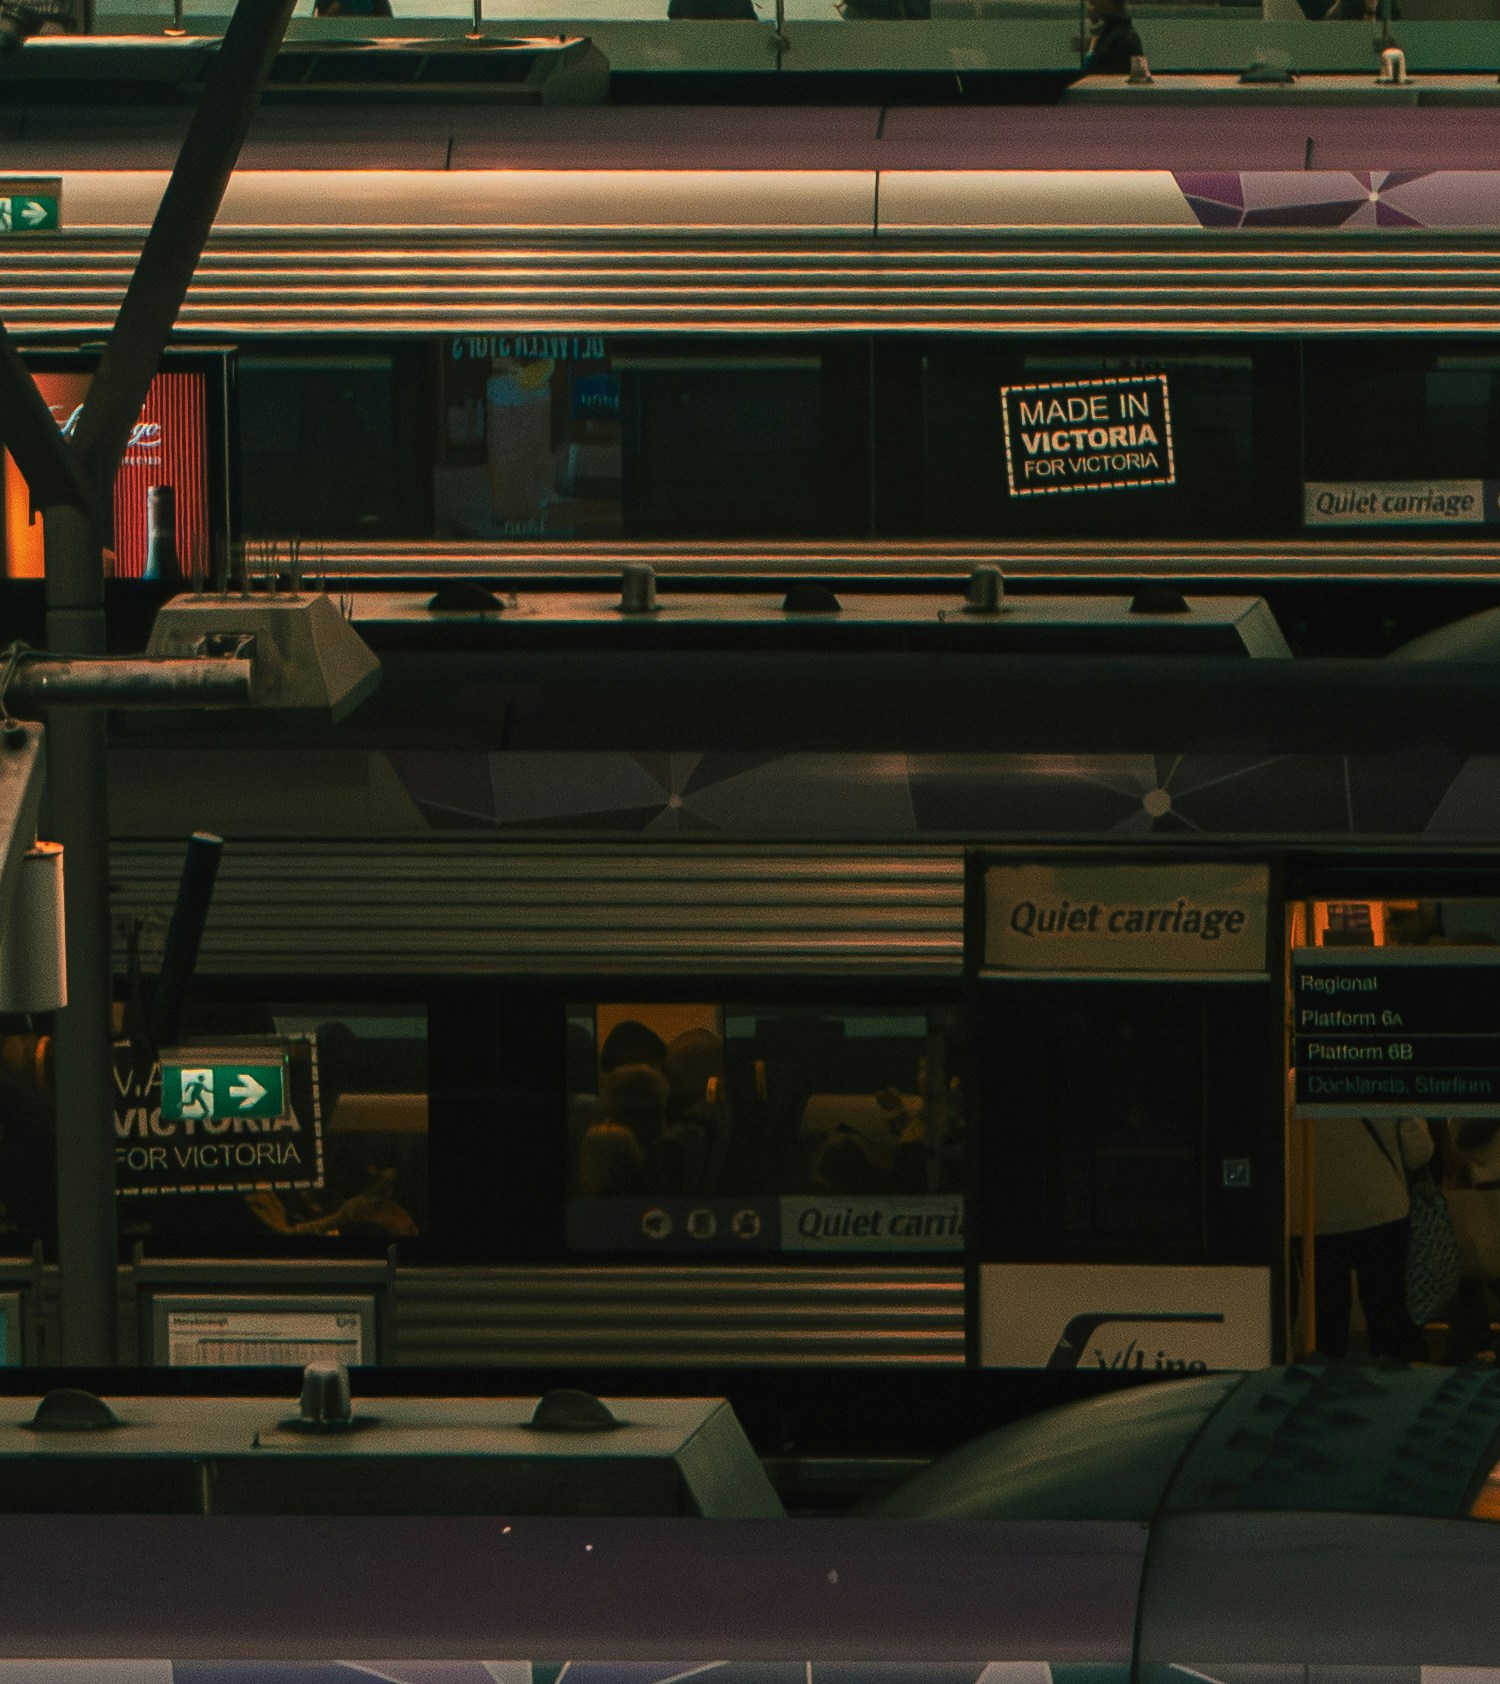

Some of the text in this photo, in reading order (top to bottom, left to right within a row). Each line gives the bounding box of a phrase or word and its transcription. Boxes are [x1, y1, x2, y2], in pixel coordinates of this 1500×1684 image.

[1019, 391, 1150, 427] MADE IN
[1020, 423, 1160, 455] VICTORIA
[1023, 451, 1160, 480] FOR VICTORIA
[1315, 488, 1475, 517] Quiet carriage
[1010, 900, 1246, 941] Quiet carriage
[1300, 975, 1379, 994] Regional
[1301, 1009, 1404, 1026] Platform 6A
[1307, 1042, 1415, 1060] Platform 6B
[174, 1141, 302, 1169] VICTORIA
[799, 1206, 962, 1240] Quiet carri
